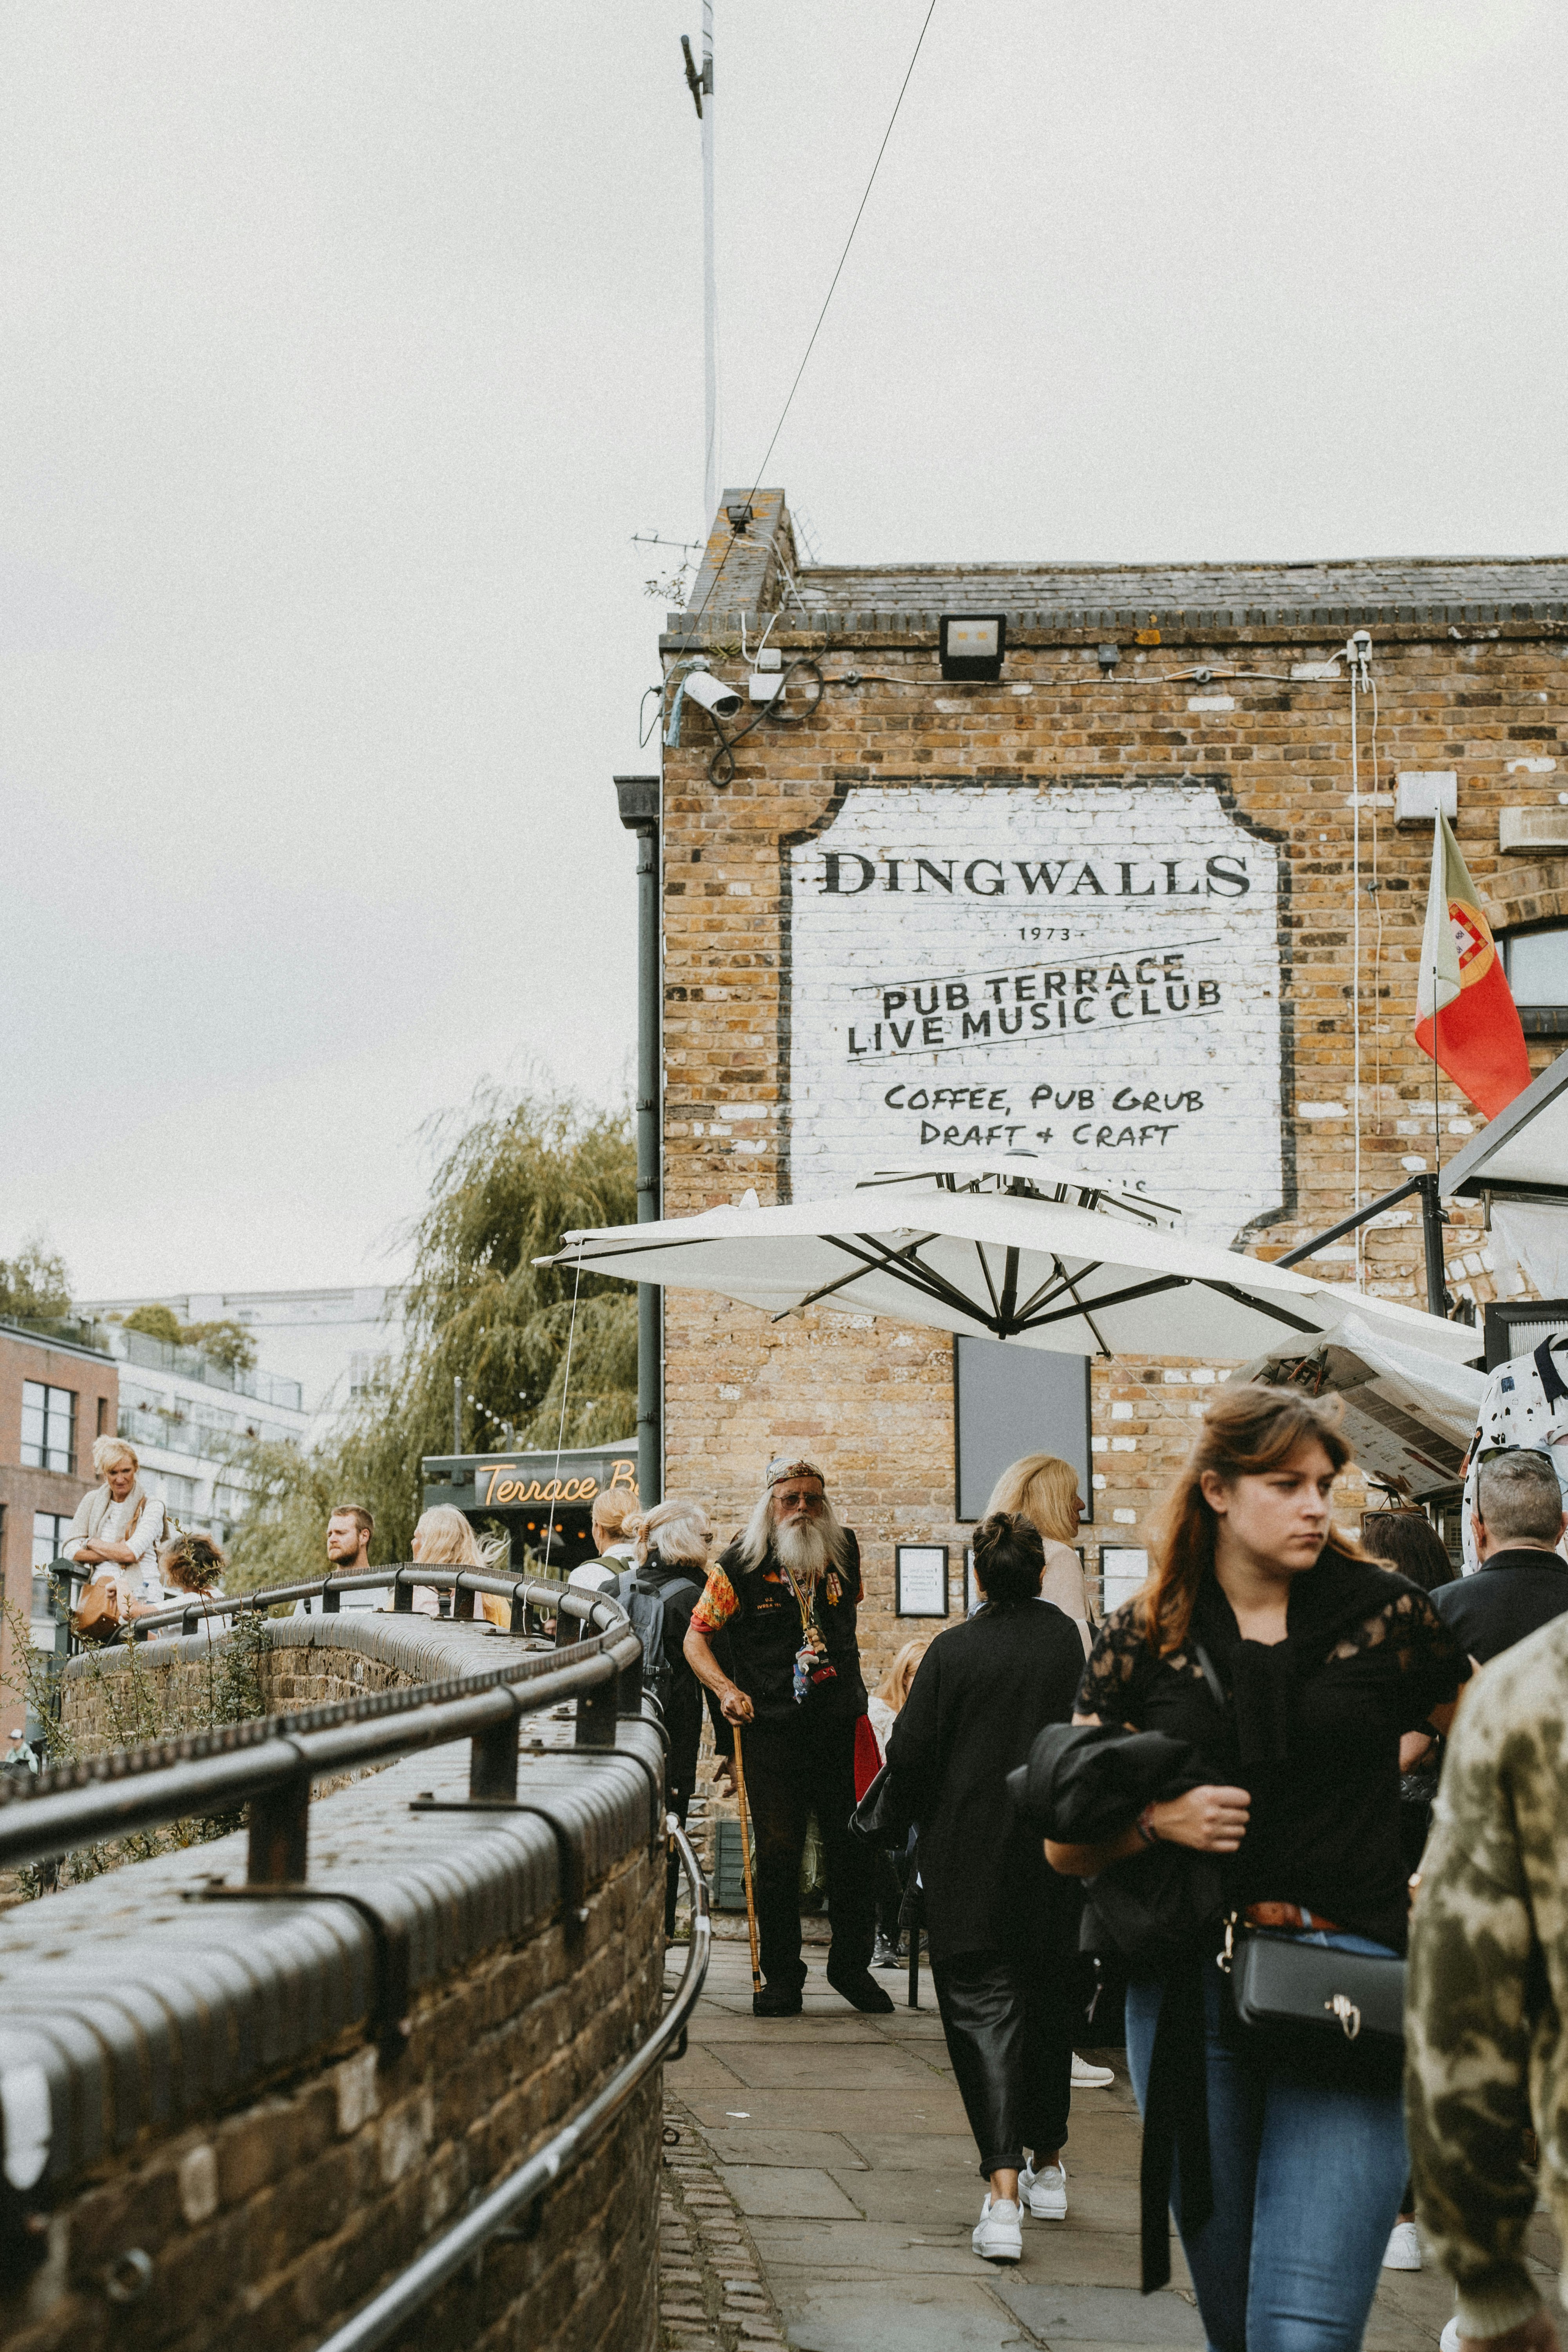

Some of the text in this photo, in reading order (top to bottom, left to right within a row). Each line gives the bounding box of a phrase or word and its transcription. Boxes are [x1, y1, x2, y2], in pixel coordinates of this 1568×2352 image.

[818, 853, 1250, 897] DINGWALLS
[1019, 927, 1069, 940] 1973
[884, 954, 1185, 1019] PUB TERRACE
[849, 980, 1221, 1053] LIVE MUSIC CLUB
[885, 1084, 1204, 1116] COFFEE, PUB GRUB
[921, 1120, 1026, 1146] DRAFT
[1073, 1123, 1178, 1147] CRAFT
[479, 1464, 598, 1506] Terrace
